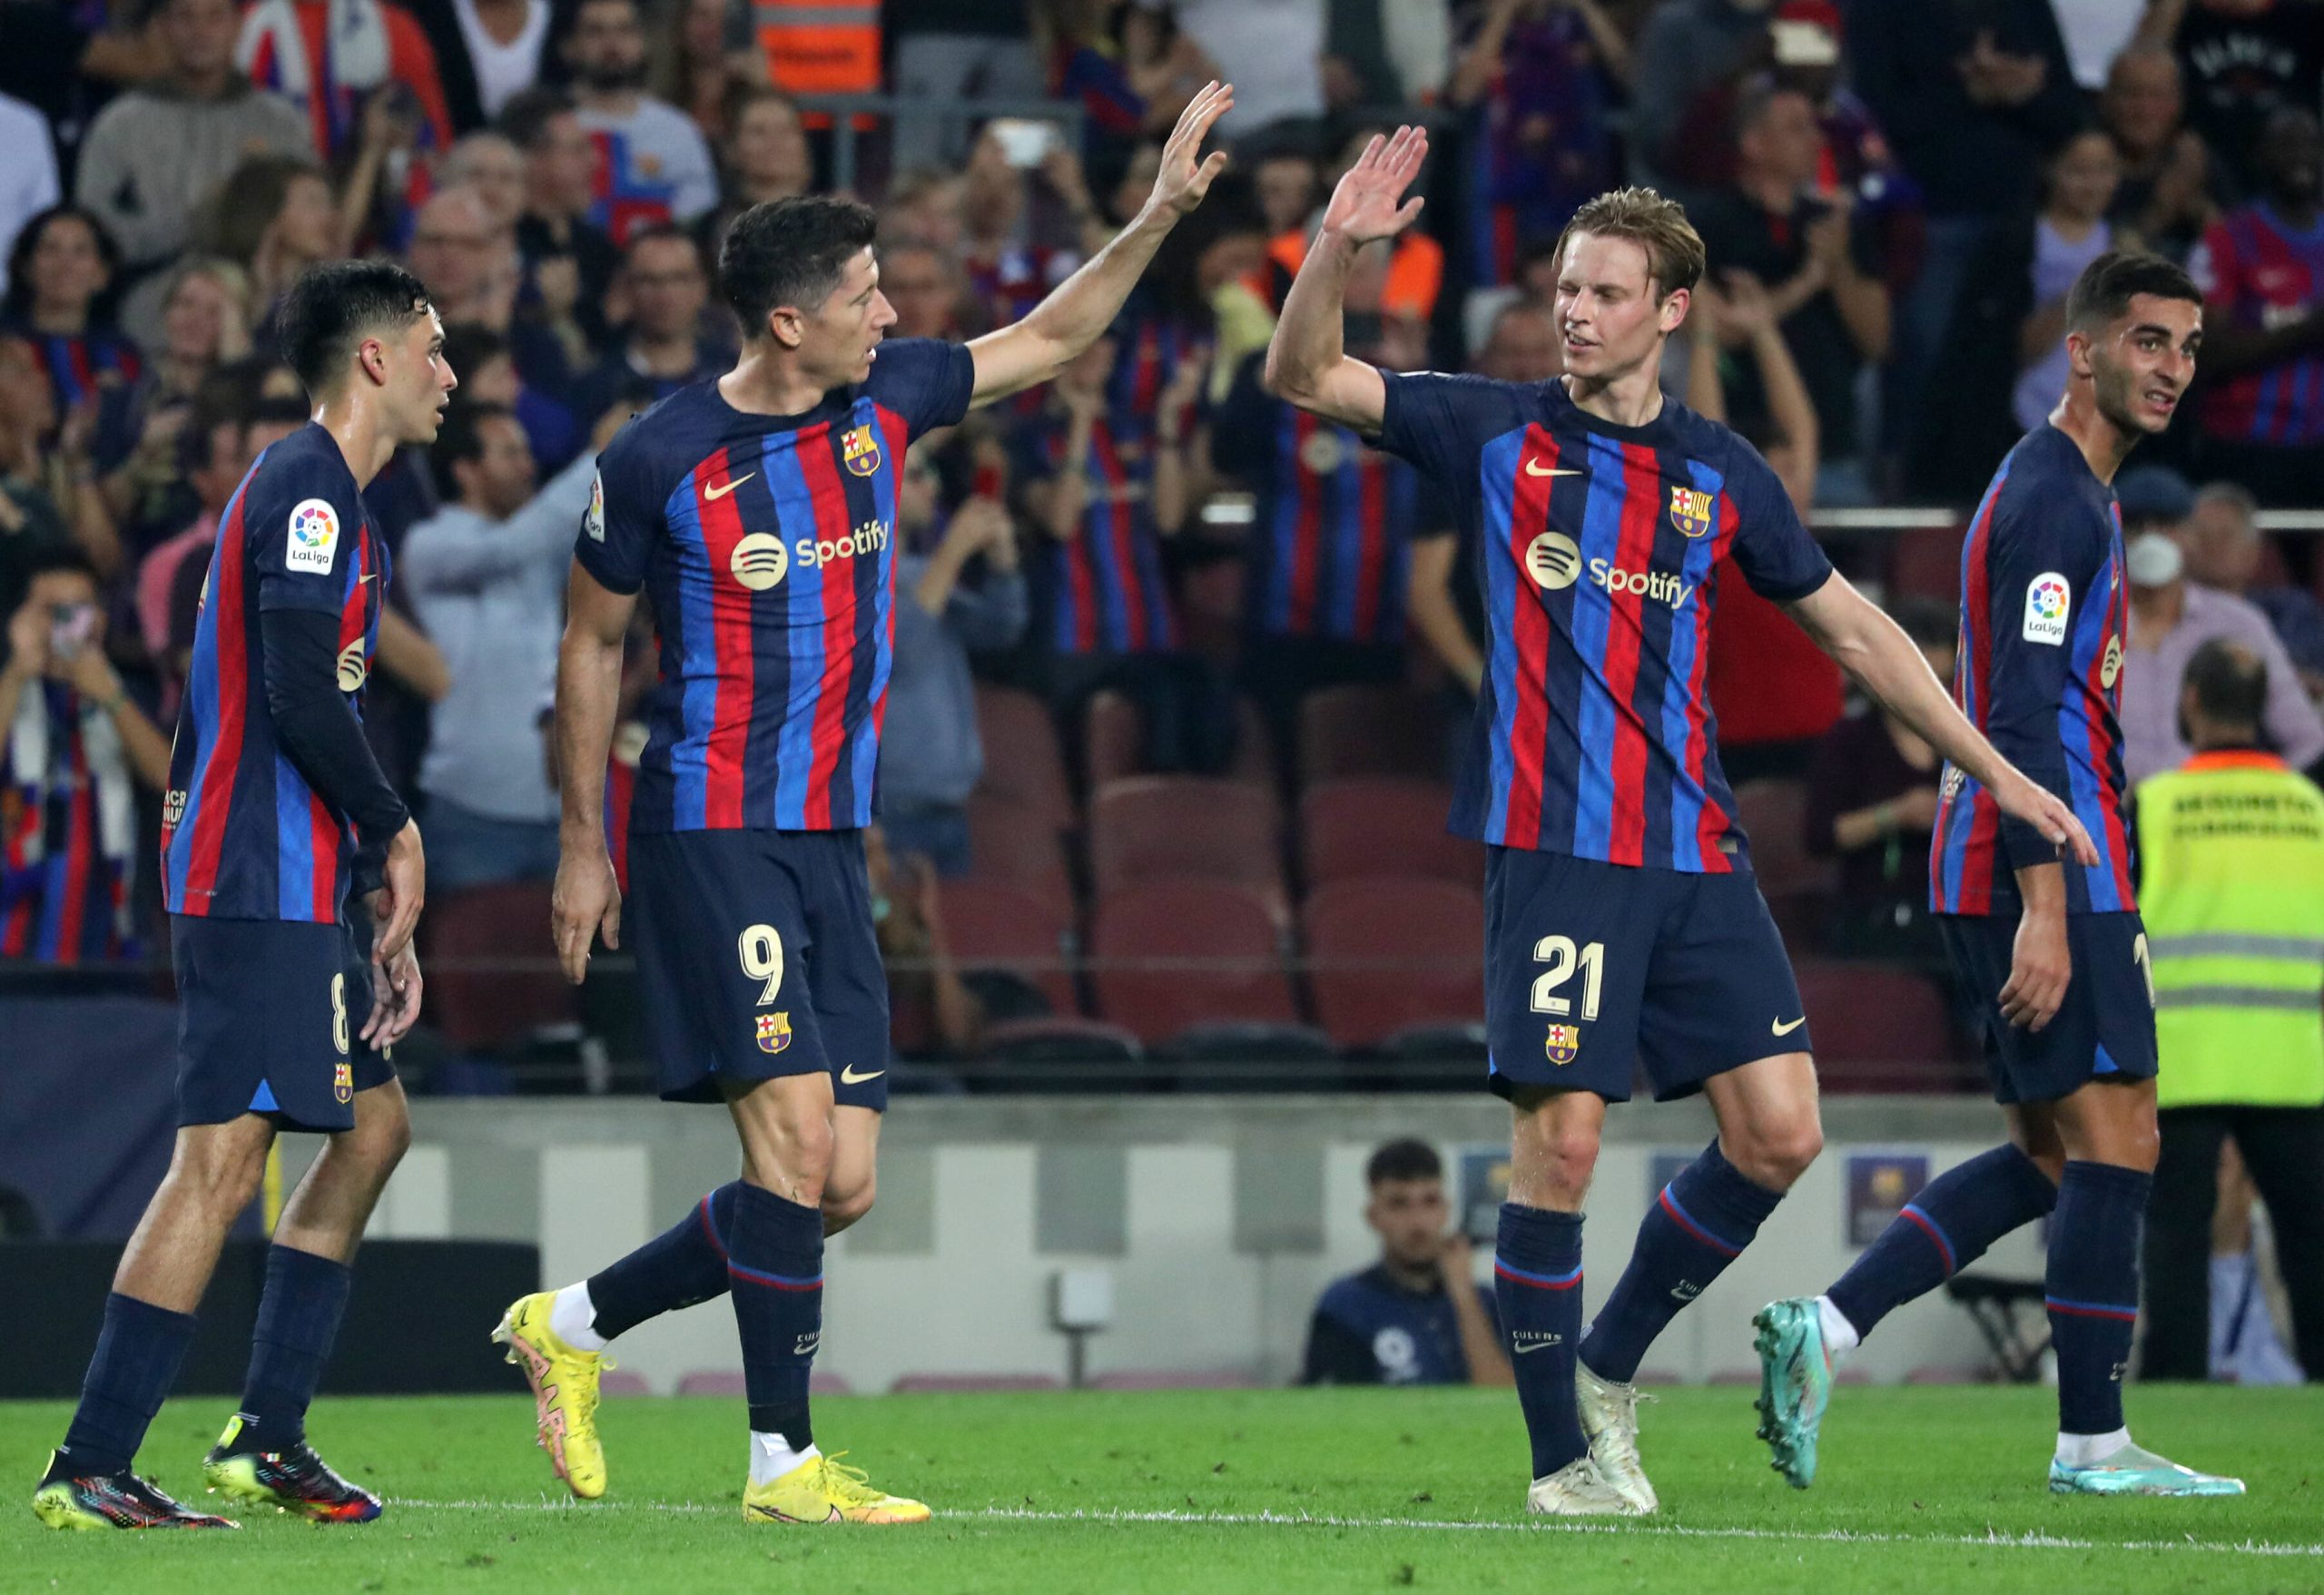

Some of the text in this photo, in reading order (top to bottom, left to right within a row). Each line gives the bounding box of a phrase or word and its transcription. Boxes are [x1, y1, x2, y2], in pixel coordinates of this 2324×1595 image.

[292, 550, 330, 565] LaLiga
[795, 519, 890, 570] Spotify
[1589, 557, 1693, 610] Spotify
[2029, 621, 2063, 636] LaLiga
[738, 923, 784, 1007] 9
[1530, 934, 1605, 1022] 21
[330, 972, 350, 1055] 8
